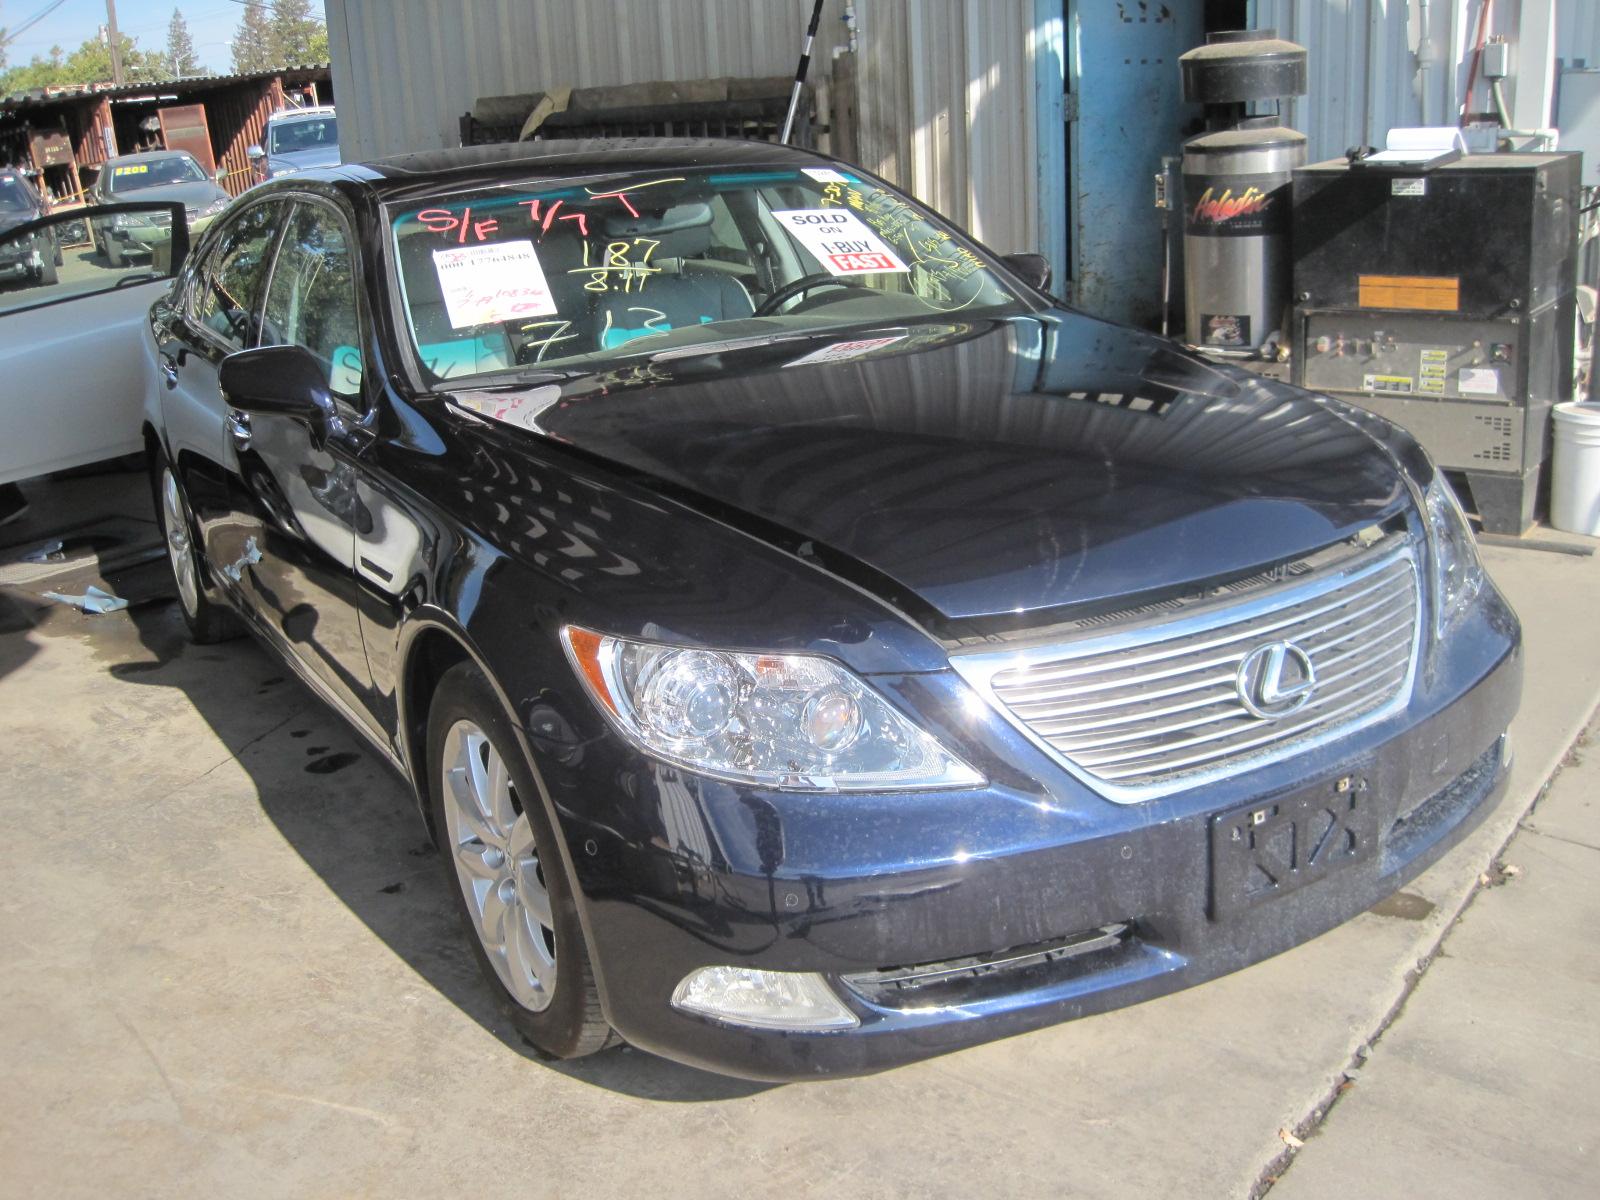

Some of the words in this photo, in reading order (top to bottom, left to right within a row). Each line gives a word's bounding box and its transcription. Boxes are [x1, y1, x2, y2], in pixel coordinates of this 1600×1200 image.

[792, 214, 848, 226] SOLD
[819, 226, 843, 234] ON
[832, 254, 891, 271] FAST
